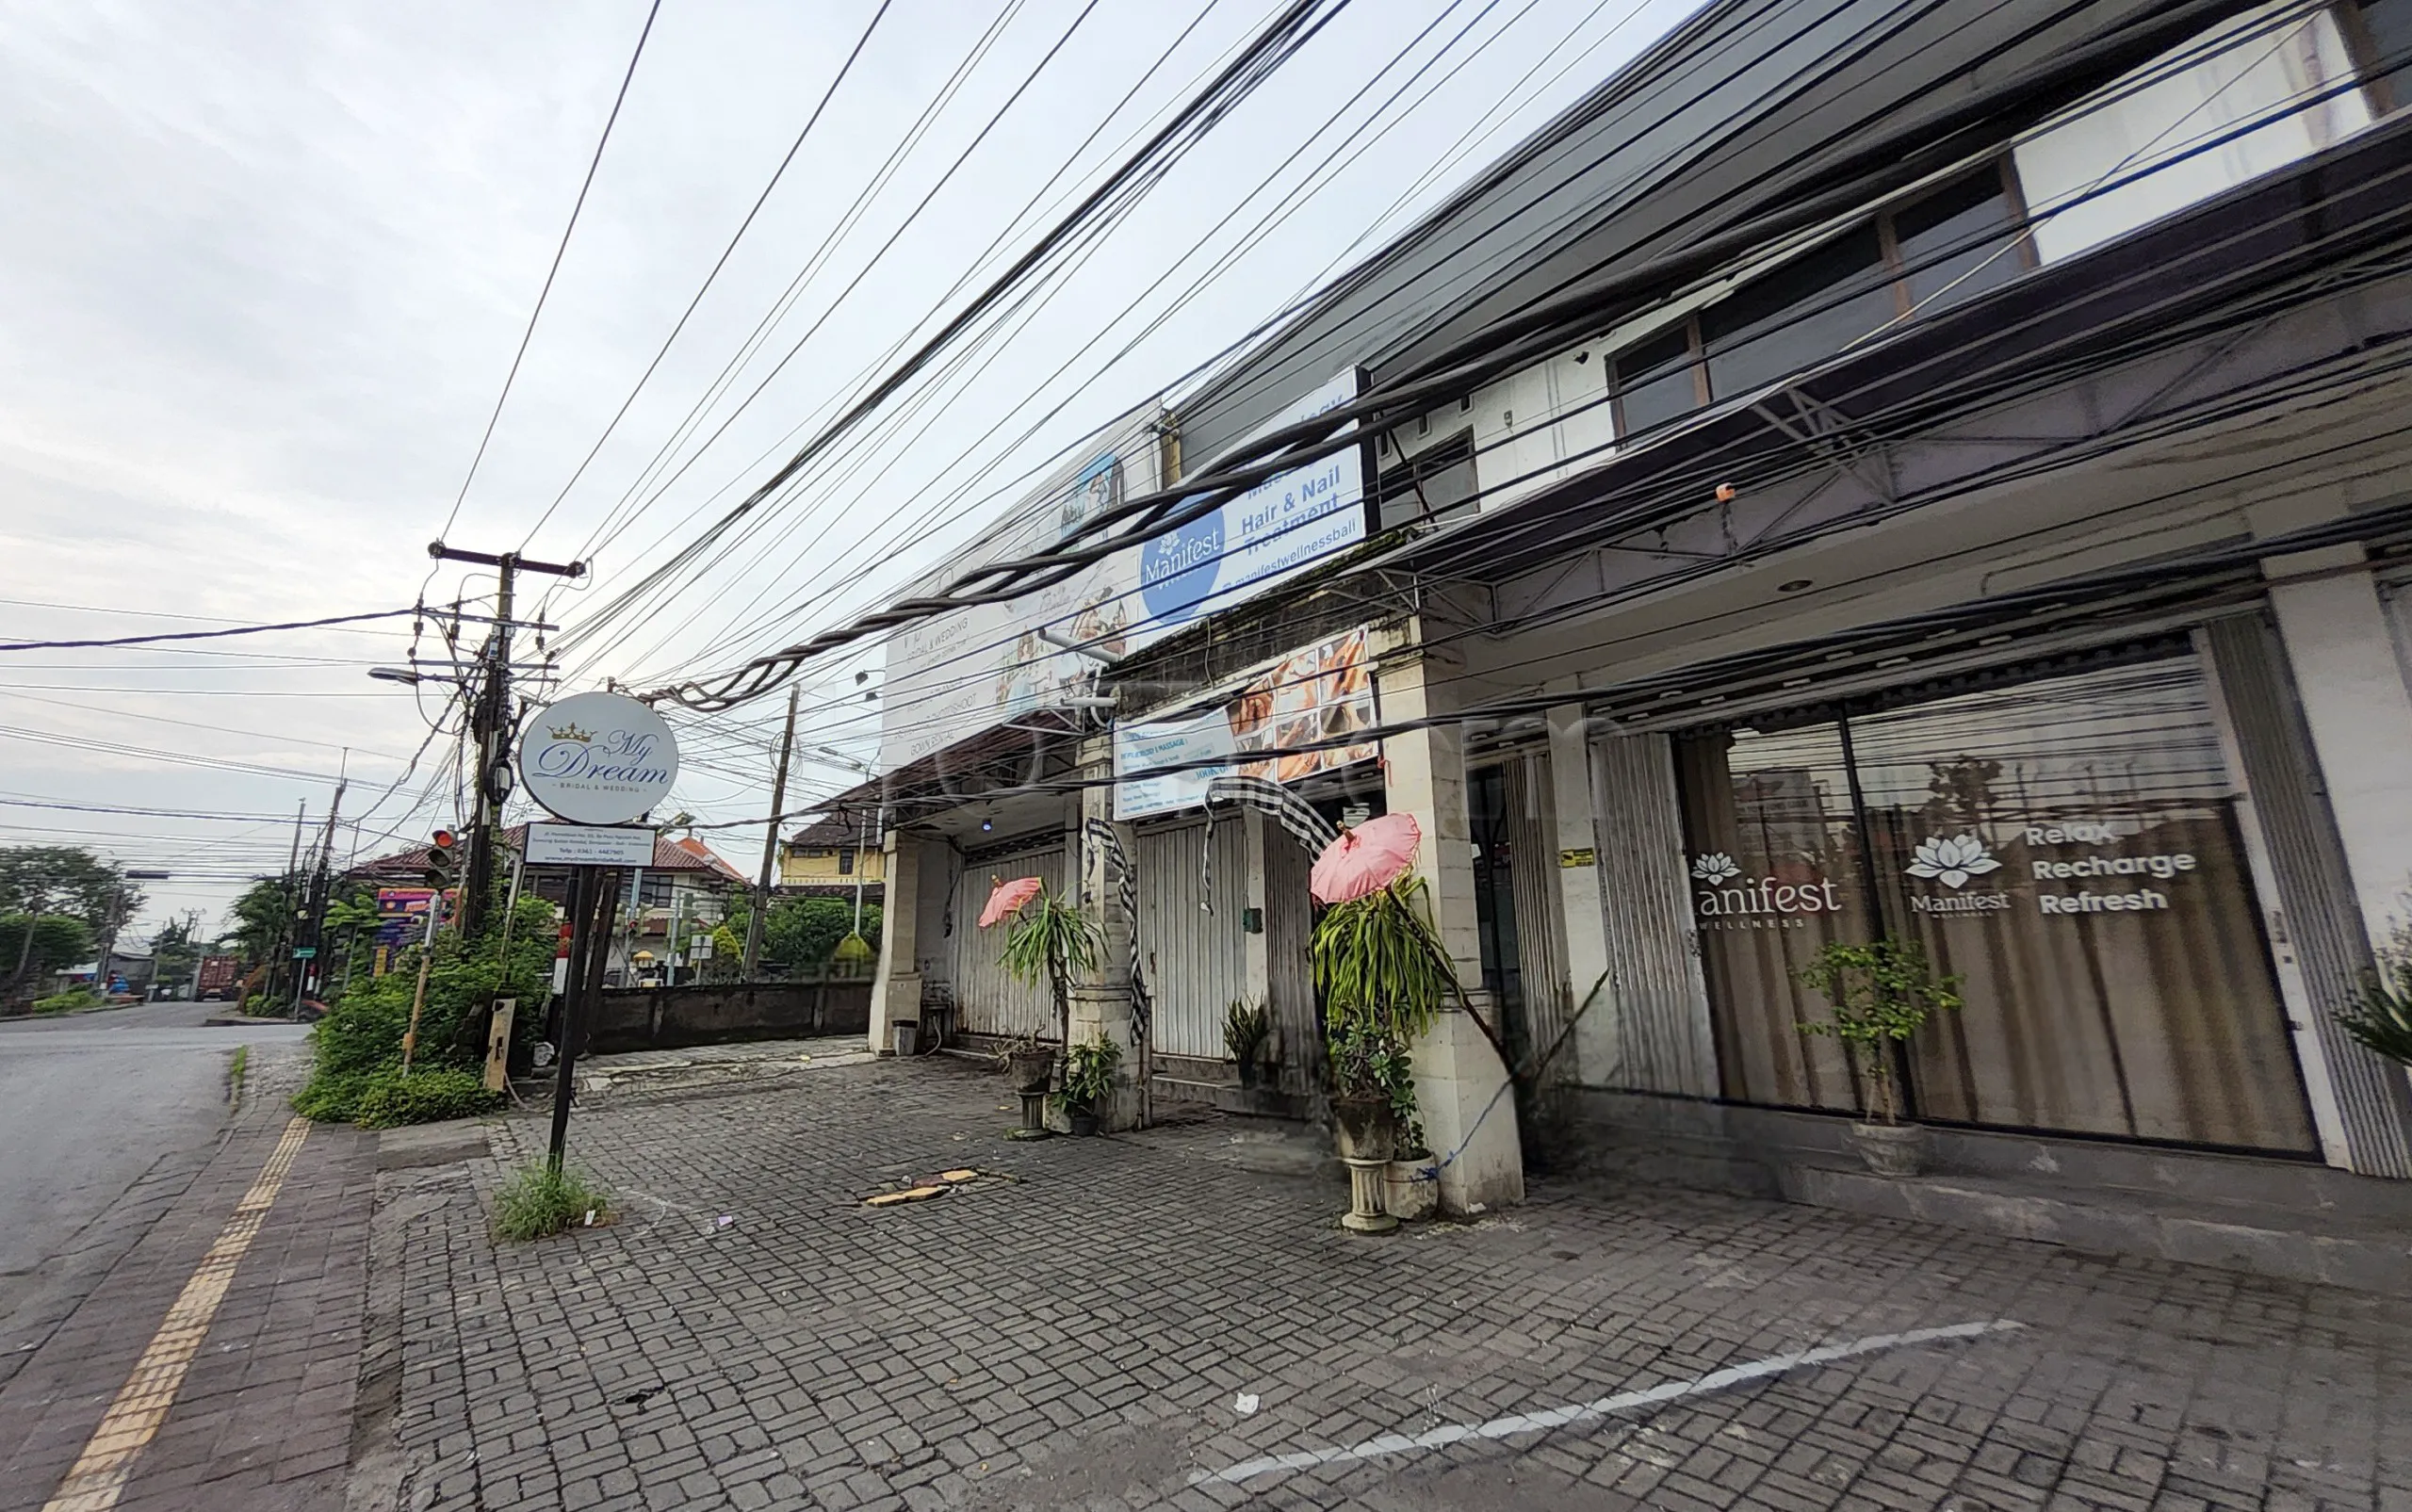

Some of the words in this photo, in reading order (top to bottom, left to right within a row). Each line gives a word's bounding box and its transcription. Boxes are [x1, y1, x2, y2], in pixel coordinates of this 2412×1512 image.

[1242, 502, 1277, 536] Hair
[1283, 492, 1295, 513] &
[1302, 464, 1341, 503] Nail
[1245, 492, 1339, 556] Treatment
[1146, 527, 1220, 585] Manifest
[531, 741, 668, 785] Dream
[608, 729, 660, 766] My
[560, 782, 591, 791] BRIDAL
[603, 783, 640, 793] WEDDING
[2028, 822, 2116, 846] Relax
[2032, 853, 2197, 880] Recharge
[1697, 876, 1842, 916] anifest
[1910, 891, 2012, 913] Manifest
[2039, 888, 2169, 914] Refresh
[1699, 918, 1804, 931] WELLNESS
